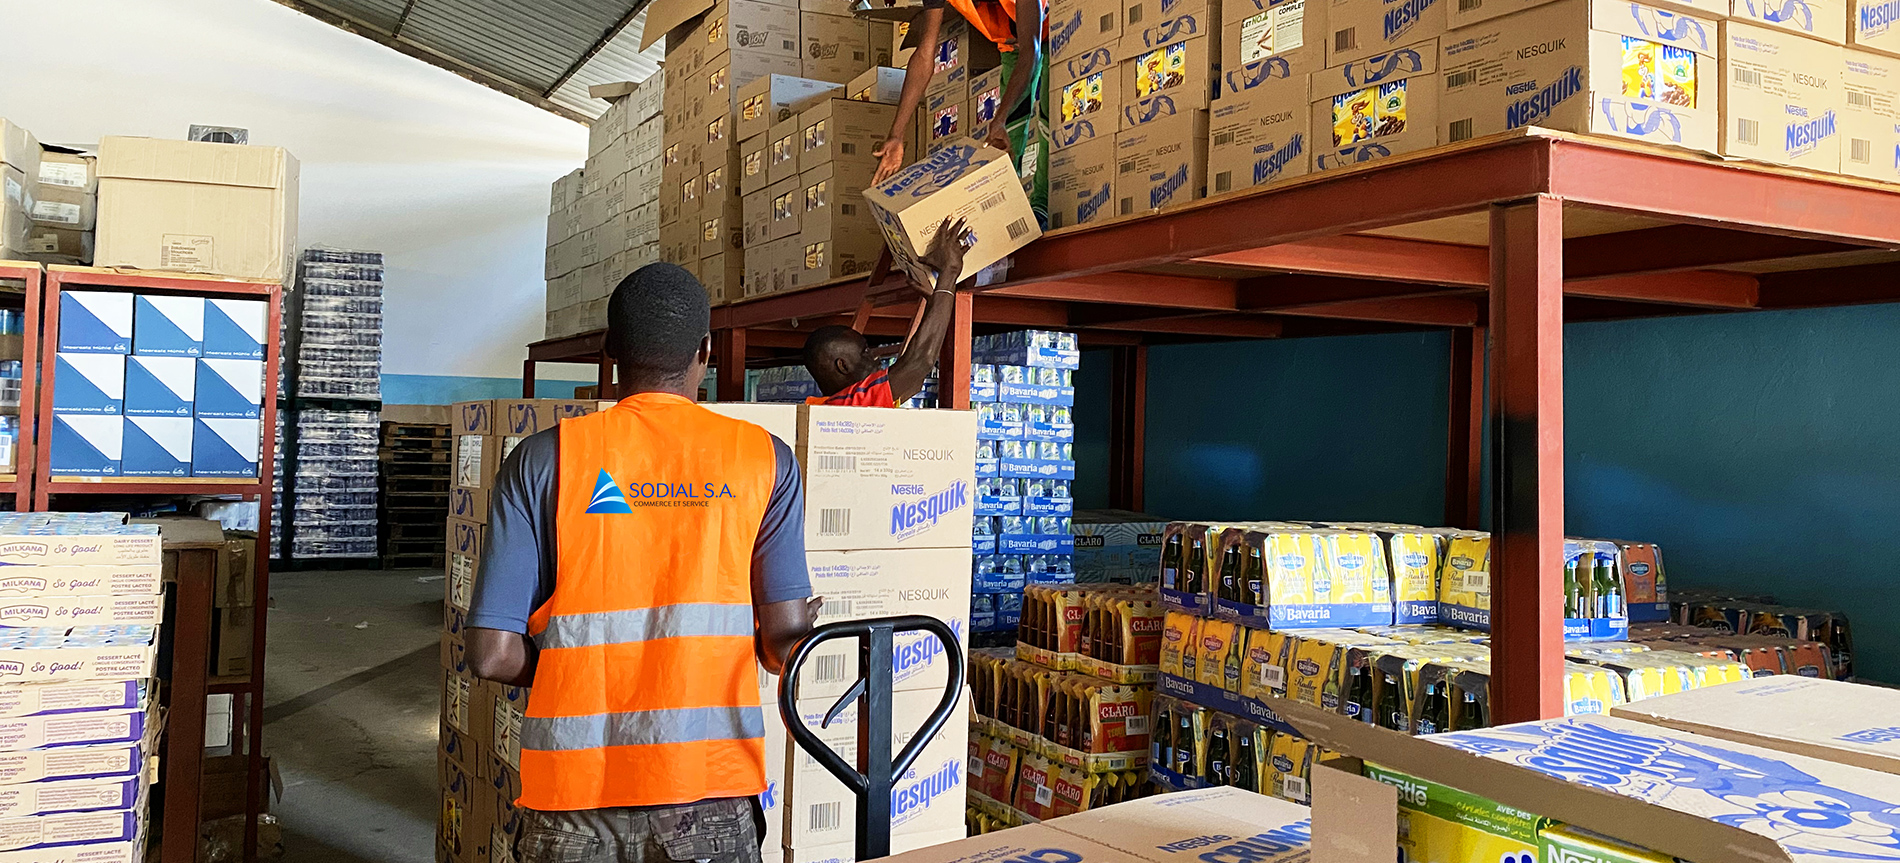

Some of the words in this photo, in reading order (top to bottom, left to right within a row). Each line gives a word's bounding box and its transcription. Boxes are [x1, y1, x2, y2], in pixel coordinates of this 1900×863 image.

[1278, 1, 1305, 15] COMPLET
[1384, 0, 1436, 40] Nesqu
[1860, 0, 1900, 32] Nesqui
[1050, 9, 1083, 56] Nesquik
[1166, 41, 1186, 57] Nesq
[1516, 38, 1566, 60] NESQUIK
[1662, 44, 1692, 60] Nesq
[1505, 80, 1537, 96] Nestlé
[1792, 72, 1828, 90] NESQUIK
[1378, 78, 1407, 100] Nesq
[1506, 66, 1582, 130] Nesquik
[1259, 110, 1294, 127] NESQUIK
[1785, 104, 1808, 118] Nestlé
[1785, 110, 1836, 152] Nesquik
[1155, 142, 1182, 156] NESQUIK
[1252, 133, 1303, 186] Nesquik
[883, 144, 964, 198] Nesquik
[1082, 163, 1105, 177] NESQUIK
[1150, 163, 1188, 209] Nesquik
[1077, 183, 1111, 224] Nesquik
[919, 212, 955, 238] NESQK
[1009, 387, 1038, 396] Bavaria
[982, 426, 1006, 434] Bavaria
[1032, 428, 1056, 436] Bavaria
[902, 449, 954, 461] NESQUIK
[1008, 462, 1038, 472] Bavaria
[629, 482, 699, 498] SODIAL
[704, 482, 736, 498] S.A.
[891, 484, 925, 495] Nestlé
[634, 500, 672, 508] COMMERCE
[682, 500, 710, 508] SERVICE
[890, 480, 968, 535] Nesquik
[978, 501, 1003, 510] Bavaria
[1030, 502, 1054, 511] Bavaria
[1008, 540, 1038, 548] Bavaria
[1074, 537, 1102, 546] CLARO
[54, 544, 68, 554] So
[70, 544, 102, 556] Good!
[2, 580, 42, 588] MILKANA
[53, 578, 66, 588] So
[70, 579, 101, 590] Good!
[898, 588, 950, 601] NESQUIK
[1164, 594, 1182, 604] Bavaria
[4, 608, 44, 616] MILKANA
[55, 606, 68, 616] So
[72, 606, 103, 619] Good!
[1286, 606, 1330, 620] Bavaria
[1412, 604, 1437, 616] Bava
[1451, 608, 1490, 624] Bavaria
[893, 618, 961, 674] Nesquk
[31, 662, 45, 672] So
[50, 662, 85, 675] Good!
[1165, 676, 1194, 694] Bavaria
[1101, 705, 1135, 718] CLARO
[987, 752, 1009, 769] CLARO
[1022, 768, 1046, 785] CLARO
[1056, 782, 1080, 801] CLARO
[1496, 805, 1516, 816] AVEC
[1516, 810, 1532, 820] DES
[1156, 834, 1233, 853] Nestlé
